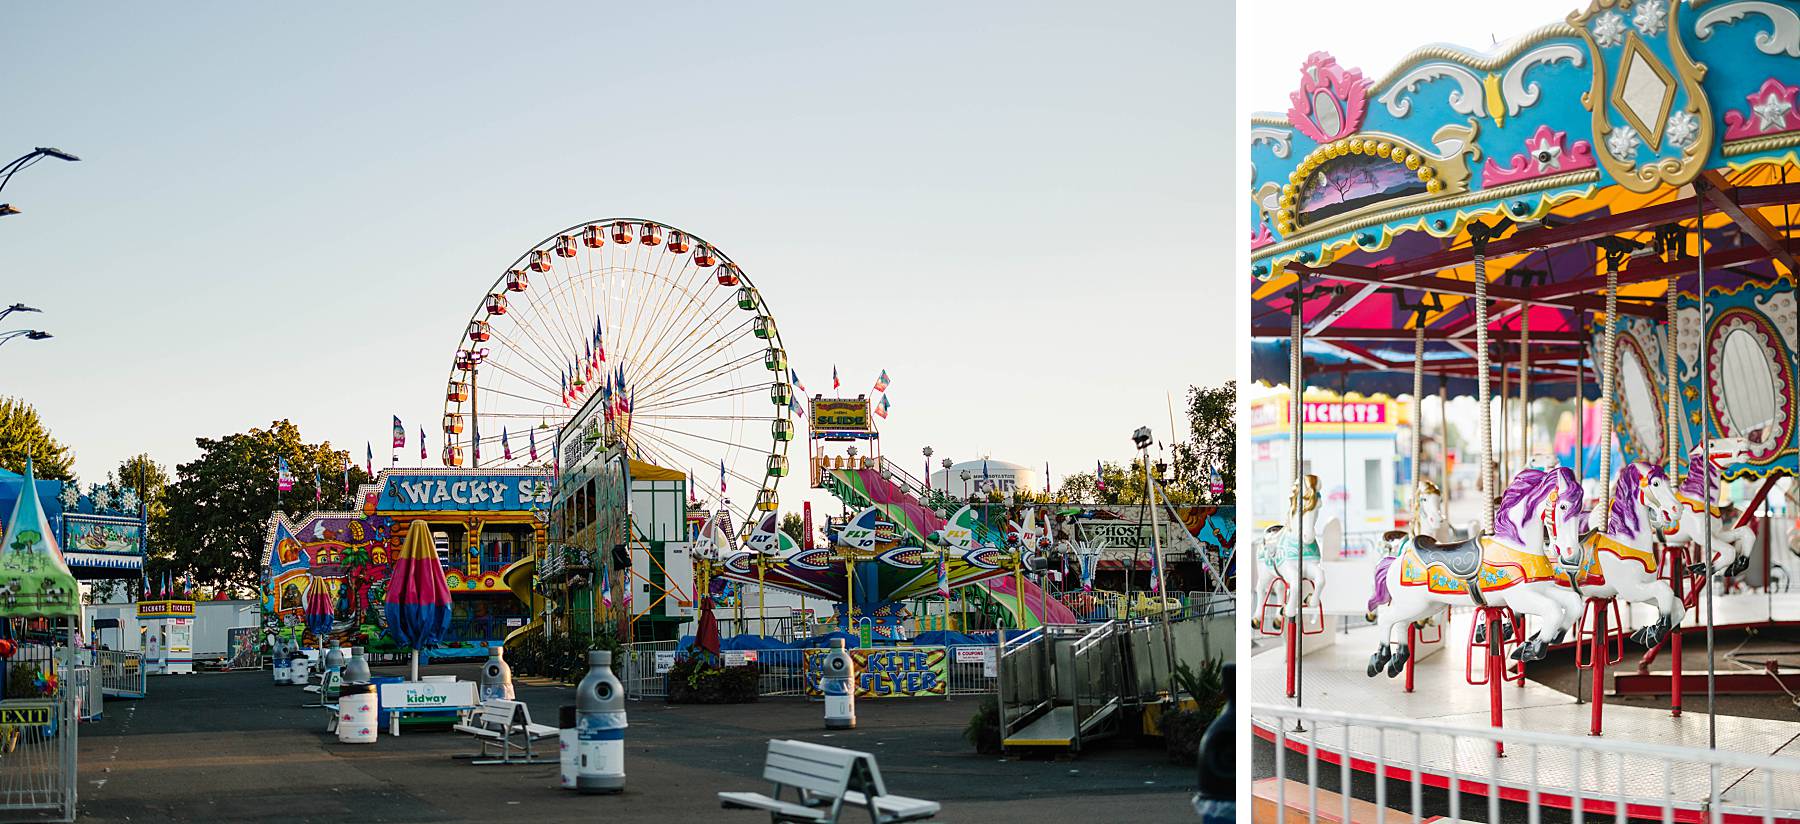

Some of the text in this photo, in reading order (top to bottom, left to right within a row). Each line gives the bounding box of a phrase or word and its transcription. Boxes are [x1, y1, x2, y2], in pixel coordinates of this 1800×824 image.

[818, 415, 865, 425] SLIDE
[401, 480, 508, 504] WACKY
[845, 530, 871, 538] FLY
[946, 530, 968, 538] FLY
[1023, 532, 1034, 540] FLY
[1095, 526, 1141, 536] GHOST
[750, 535, 771, 543] FLY
[867, 652, 929, 672] KITE
[861, 672, 937, 693] FLYER
[407, 695, 447, 703] kidway
[1, 709, 48, 723] EXIT
